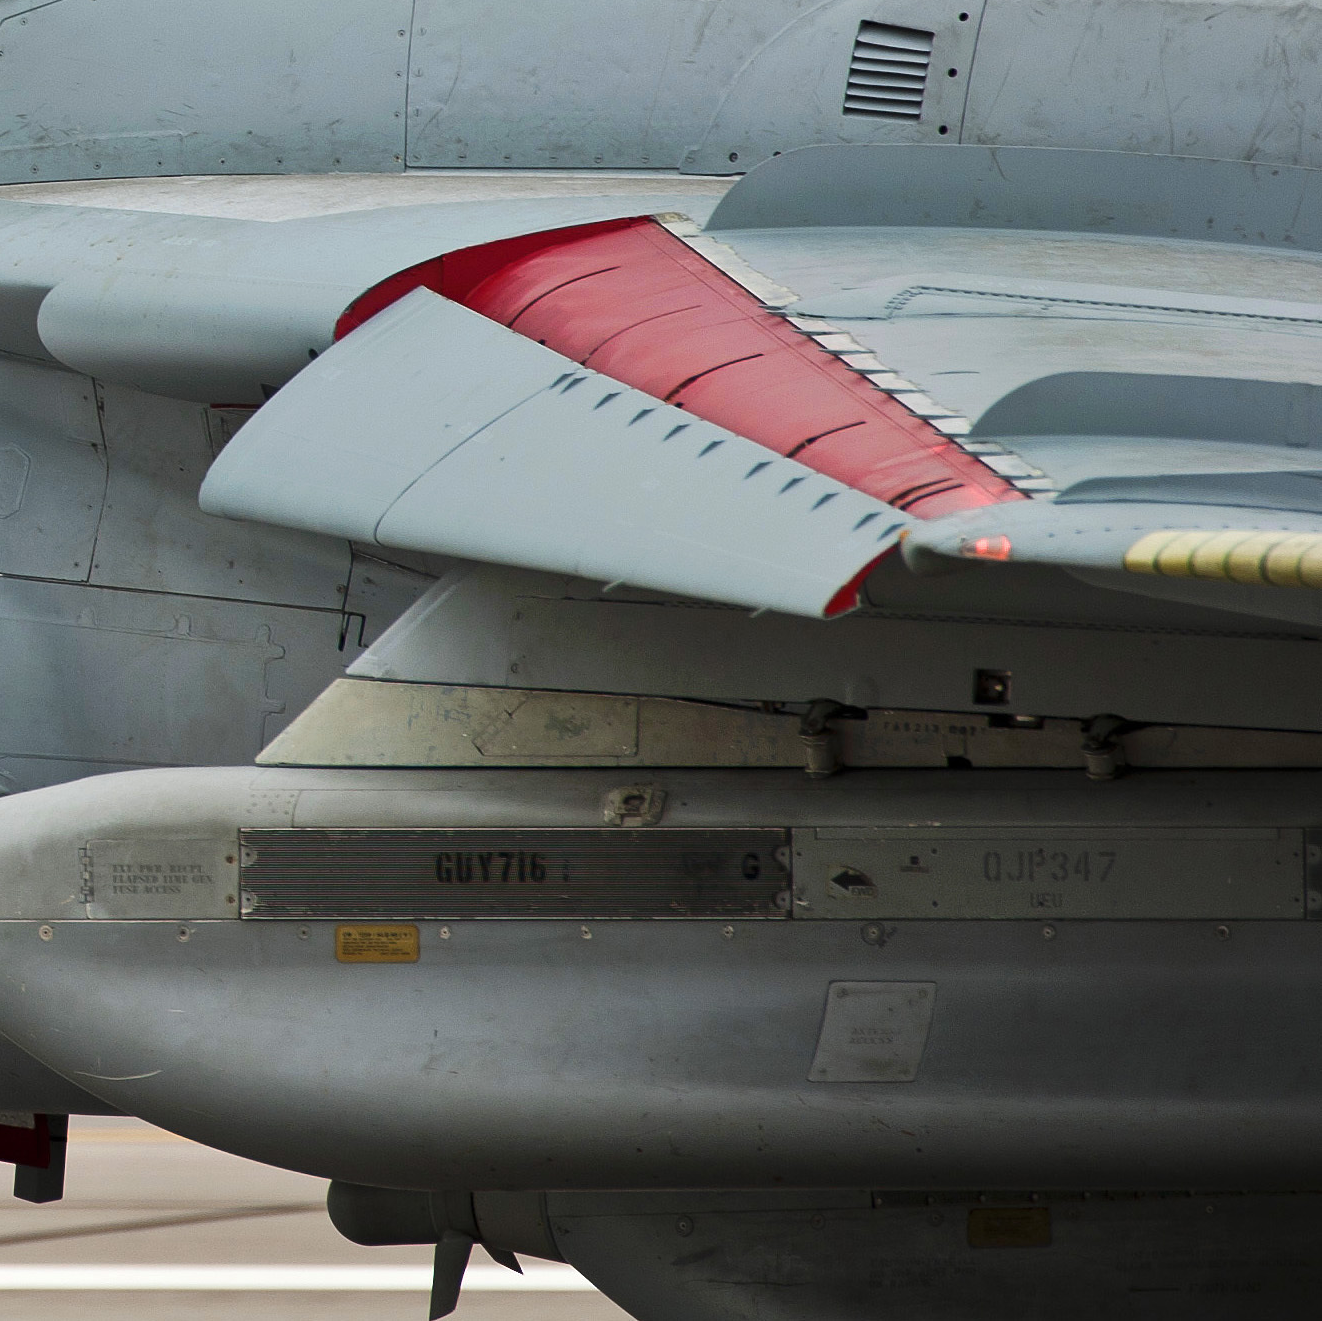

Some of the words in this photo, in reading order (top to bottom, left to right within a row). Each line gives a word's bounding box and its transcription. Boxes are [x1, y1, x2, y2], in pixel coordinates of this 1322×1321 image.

[435, 852, 547, 883] GUY716
[741, 852, 761, 880] G
[112, 874, 159, 884] ELAPSED
[163, 874, 188, 884] TIME
[112, 885, 139, 894] FUSE
[144, 885, 182, 894] ACCESS
